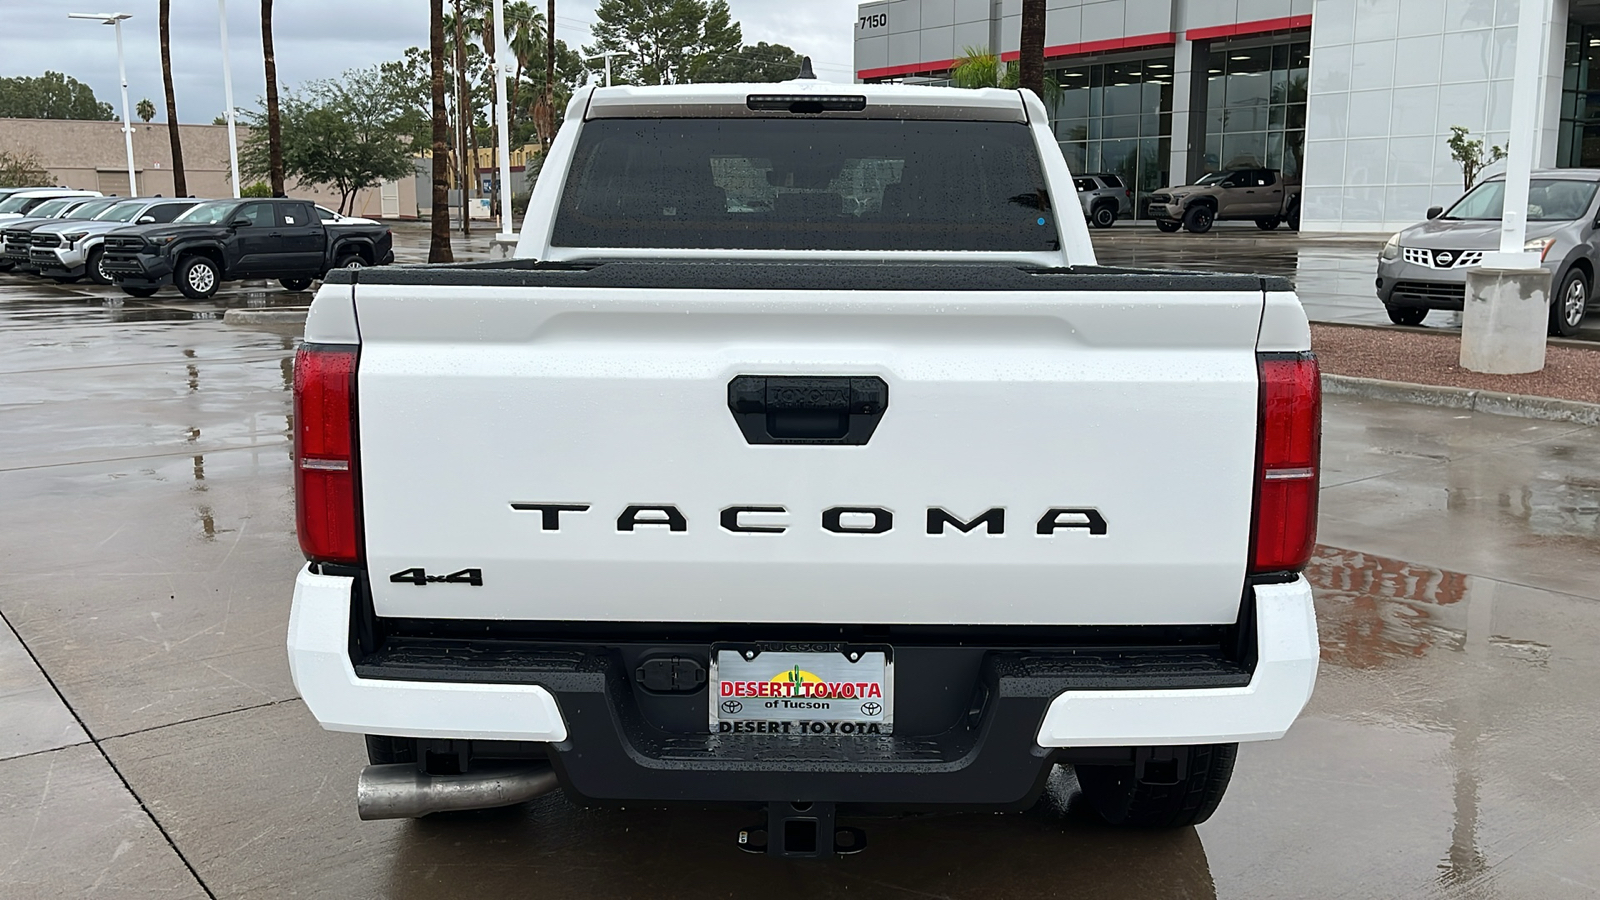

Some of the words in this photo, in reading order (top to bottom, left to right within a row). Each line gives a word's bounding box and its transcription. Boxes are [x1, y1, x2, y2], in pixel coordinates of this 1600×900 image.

[860, 13, 887, 30] 7150
[510, 502, 1108, 536] TACOMA
[756, 642, 843, 652] TUCSON
[720, 681, 795, 698] DESERT
[801, 682, 882, 699] TOYOTA
[764, 699, 781, 710] of
[782, 700, 830, 710] Tucson
[719, 721, 792, 734] DESERT
[799, 721, 881, 735] TOYOTA
